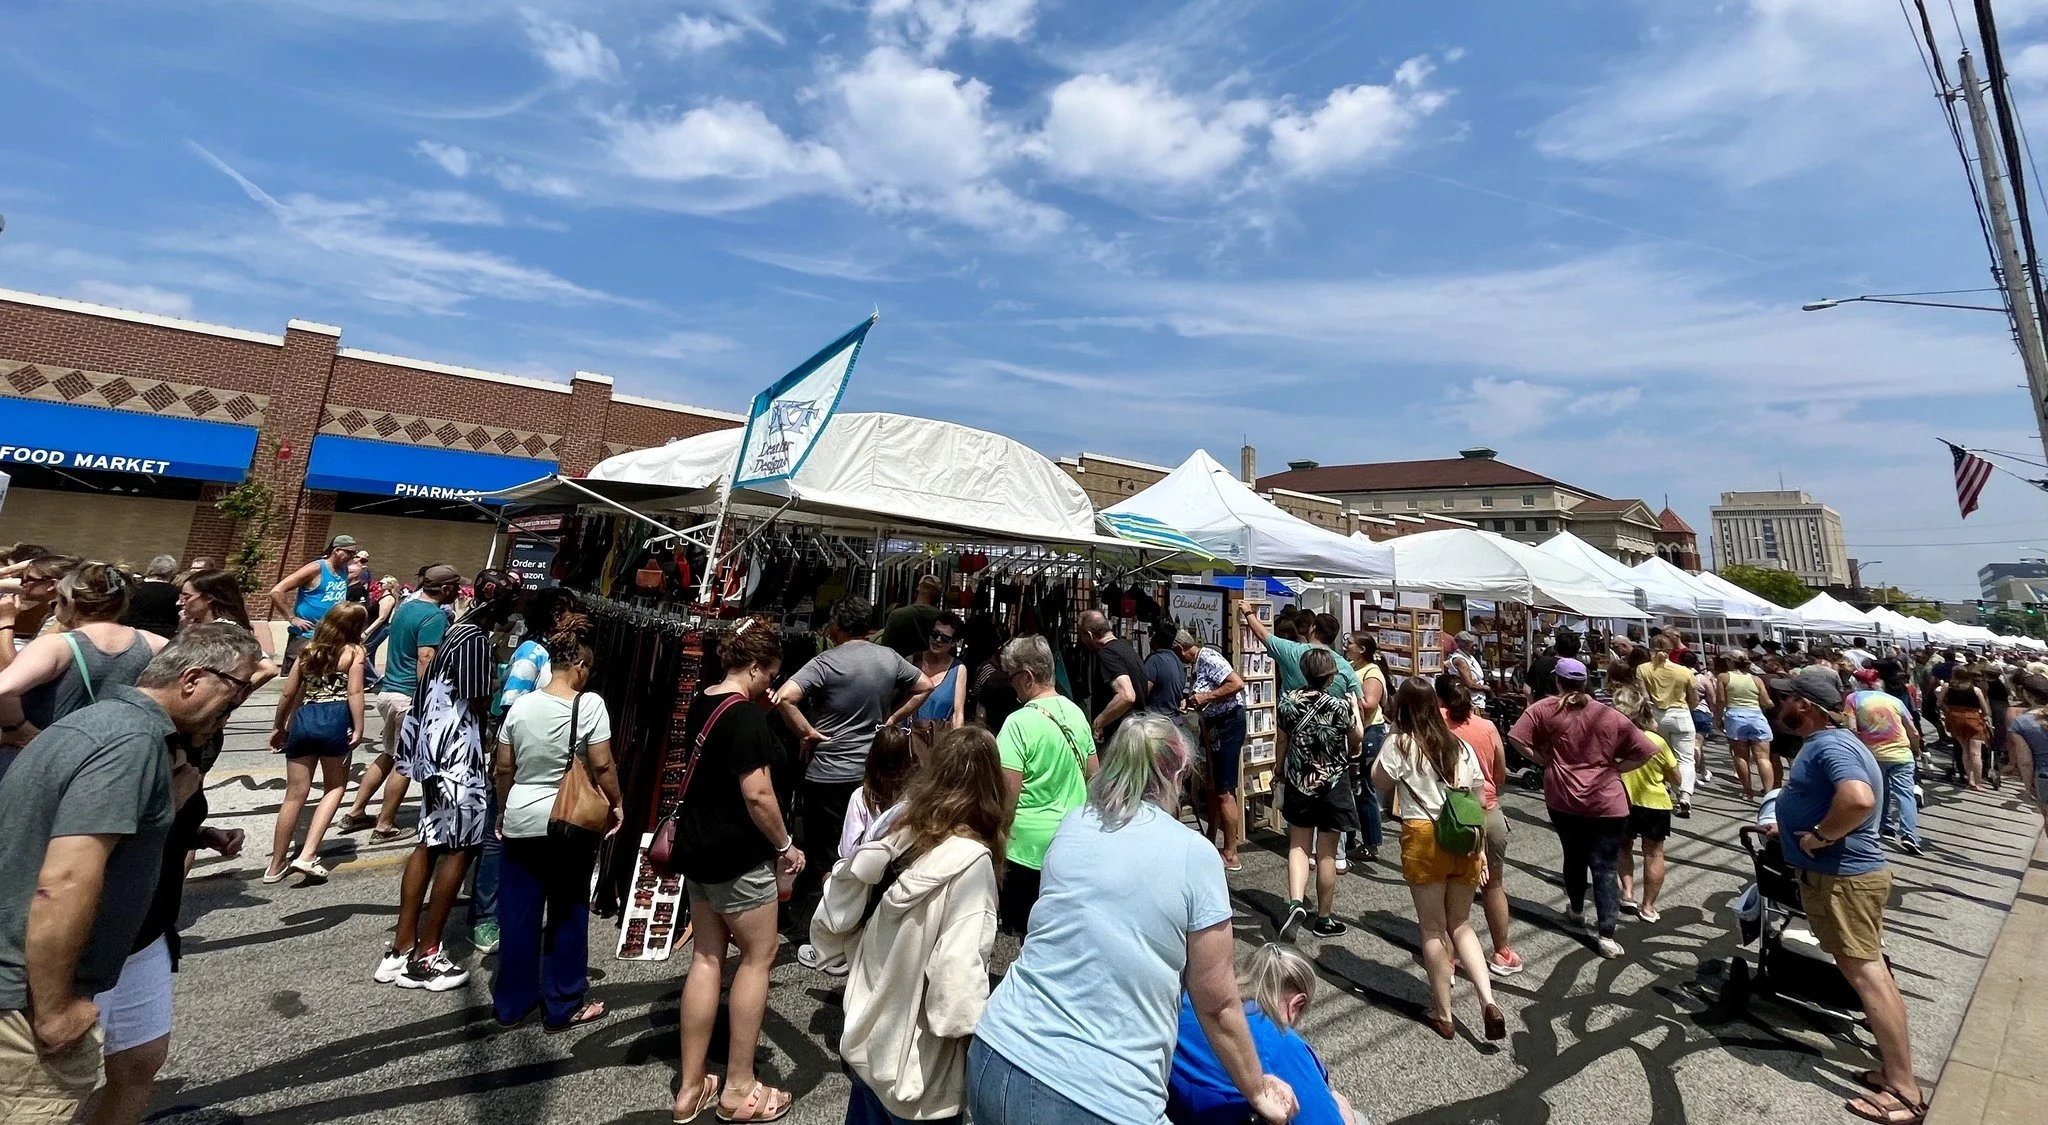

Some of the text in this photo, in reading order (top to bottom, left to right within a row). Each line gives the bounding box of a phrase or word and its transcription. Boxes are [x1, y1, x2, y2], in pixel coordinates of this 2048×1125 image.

[758, 441, 794, 458] Leather
[0, 446, 170, 474] FOOD MARKET
[752, 458, 788, 474] Designs
[512, 559, 547, 569] Order at
[522, 572, 545, 580] azon,
[1172, 595, 1218, 612] Cleveland
